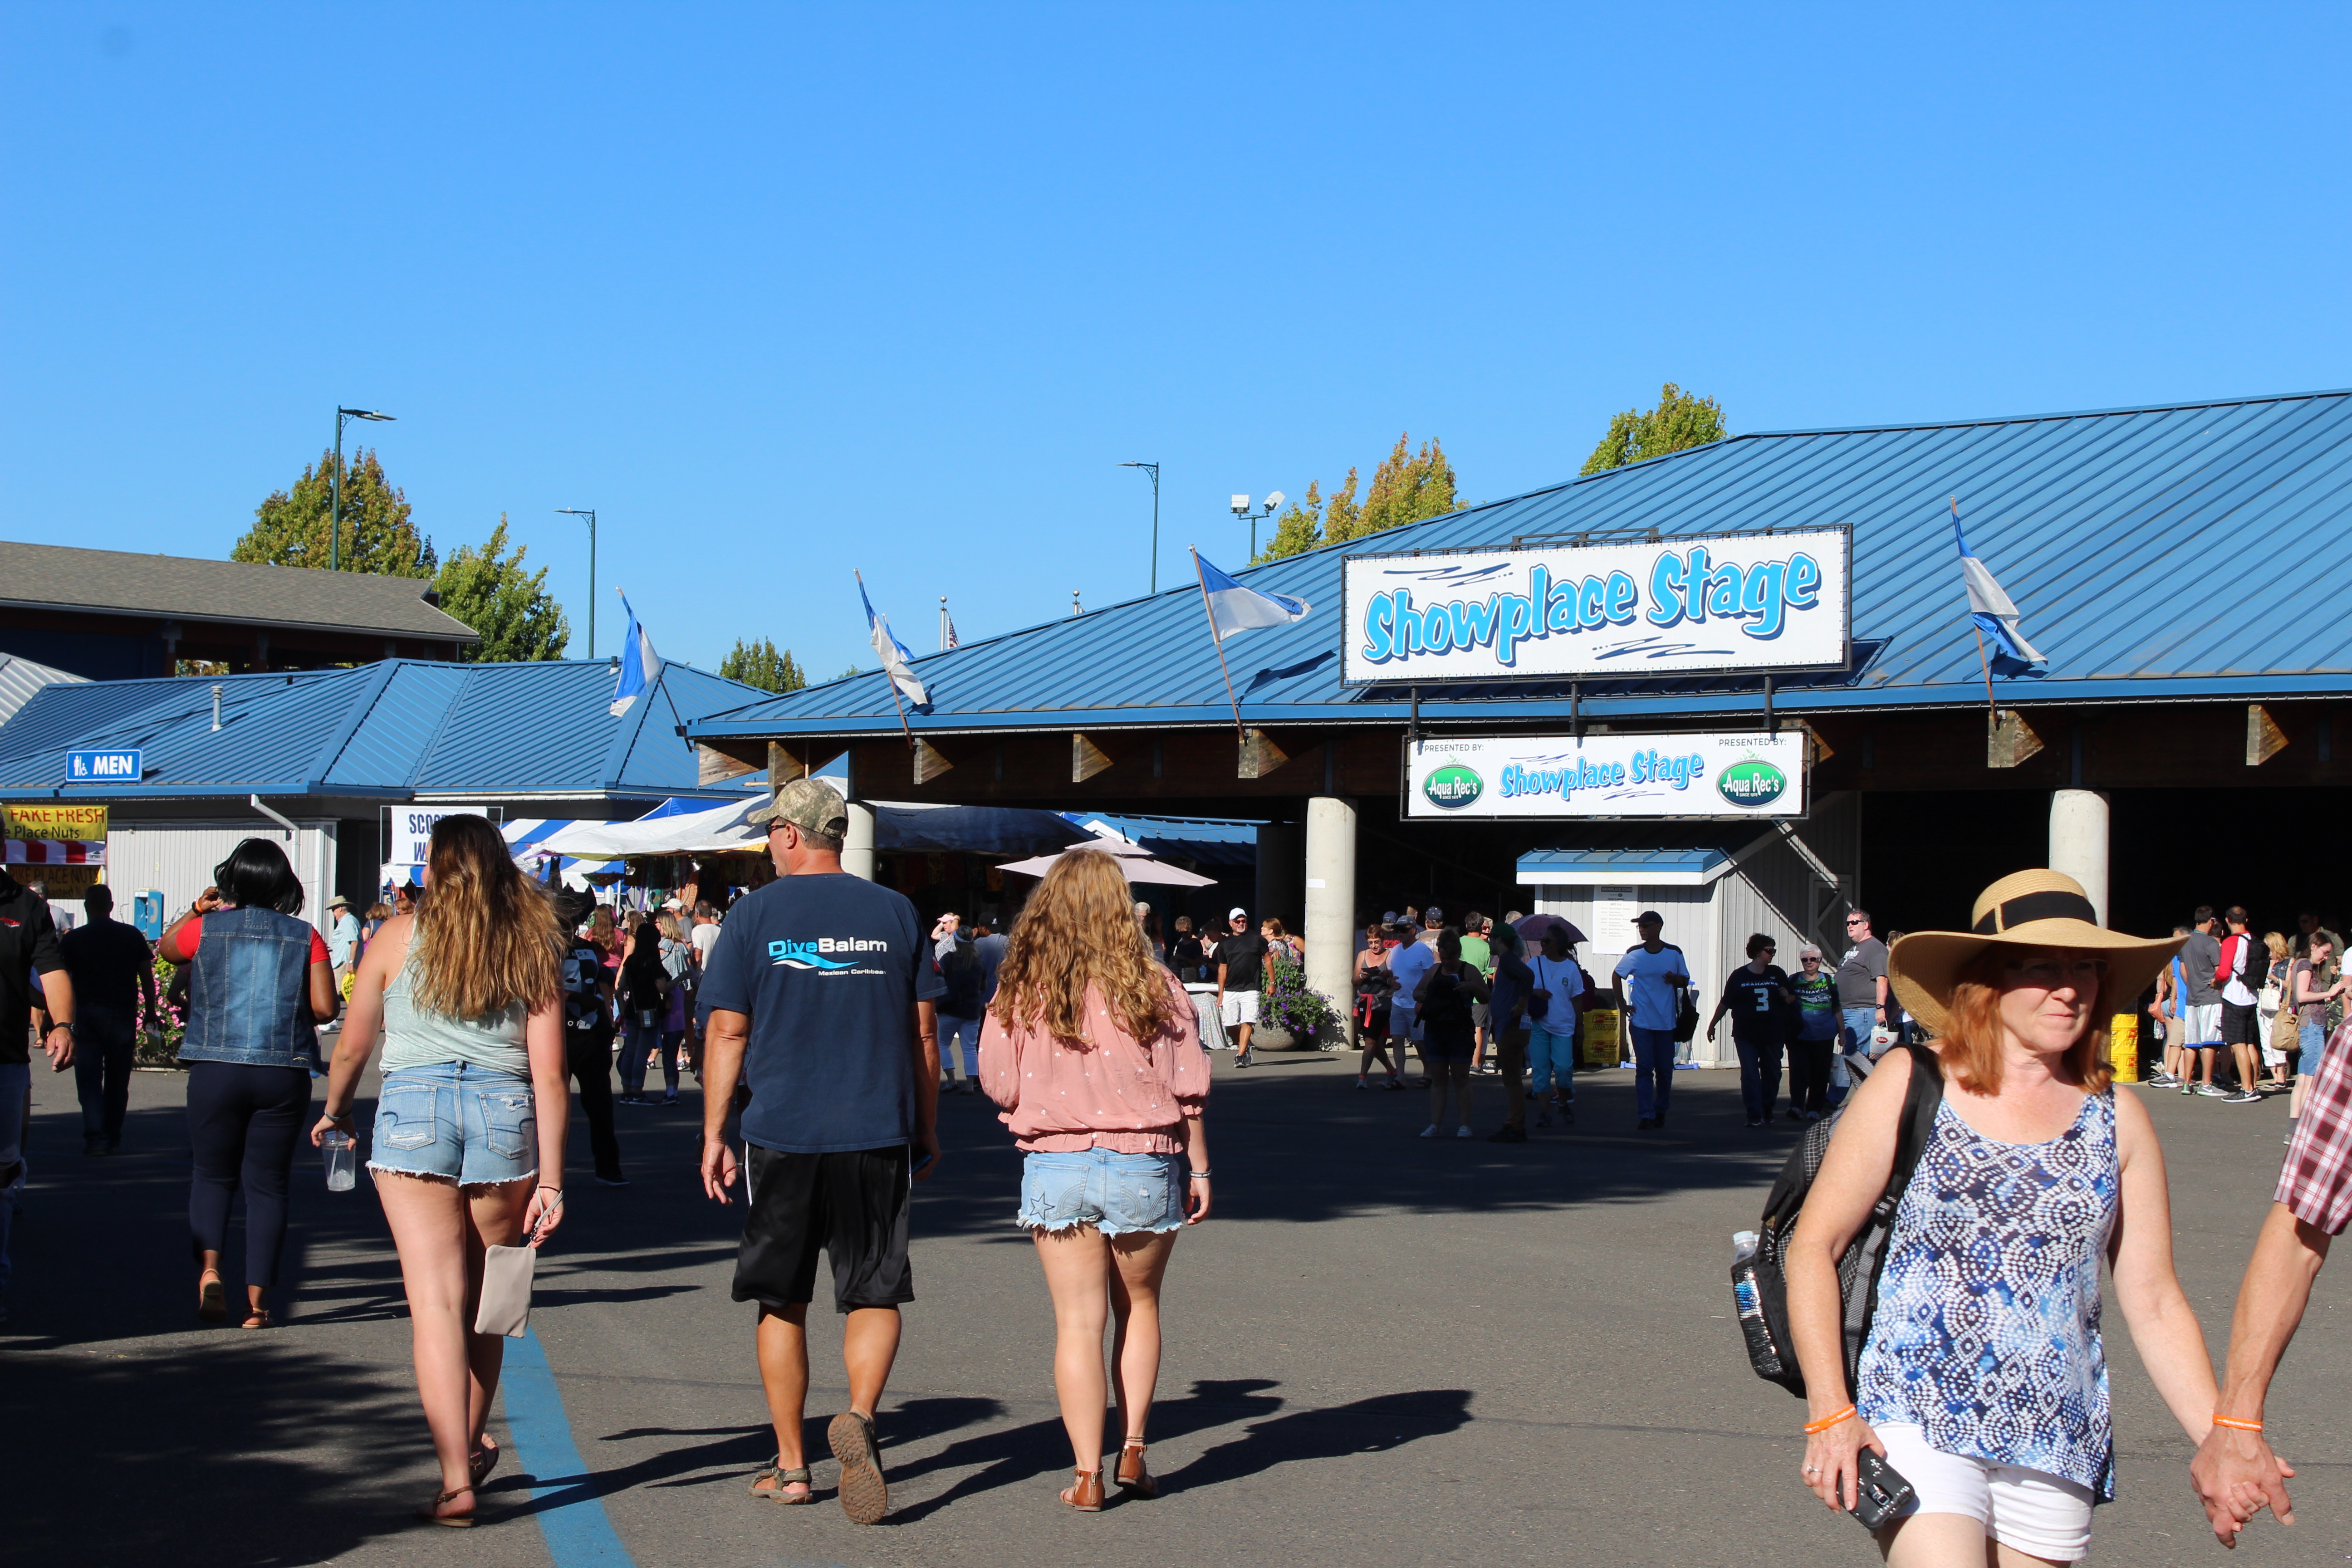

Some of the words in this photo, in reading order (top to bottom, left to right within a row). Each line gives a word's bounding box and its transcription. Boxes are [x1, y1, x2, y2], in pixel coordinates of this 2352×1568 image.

[1361, 563, 1638, 667] Showplace
[1646, 546, 1820, 640] Stage
[1425, 744, 1470, 752] PRESENTED
[1719, 738, 1769, 746] PRESENTED
[1773, 738, 1787, 746] BY:
[93, 755, 132, 775] MEN
[1499, 756, 1625, 802] Showplace
[1629, 748, 1705, 791] Stage
[1427, 776, 1452, 799] Aqua
[1454, 776, 1478, 799] Rec's
[1722, 772, 1750, 797] Aqua
[1752, 772, 1779, 796] Rec's
[56, 808, 105, 823] FRESH
[15, 825, 48, 838] Place
[51, 826, 79, 838] Nuts
[34, 867, 67, 884] PLACE
[768, 936, 887, 957] DiveBalam
[1754, 988, 1769, 1011] 3
